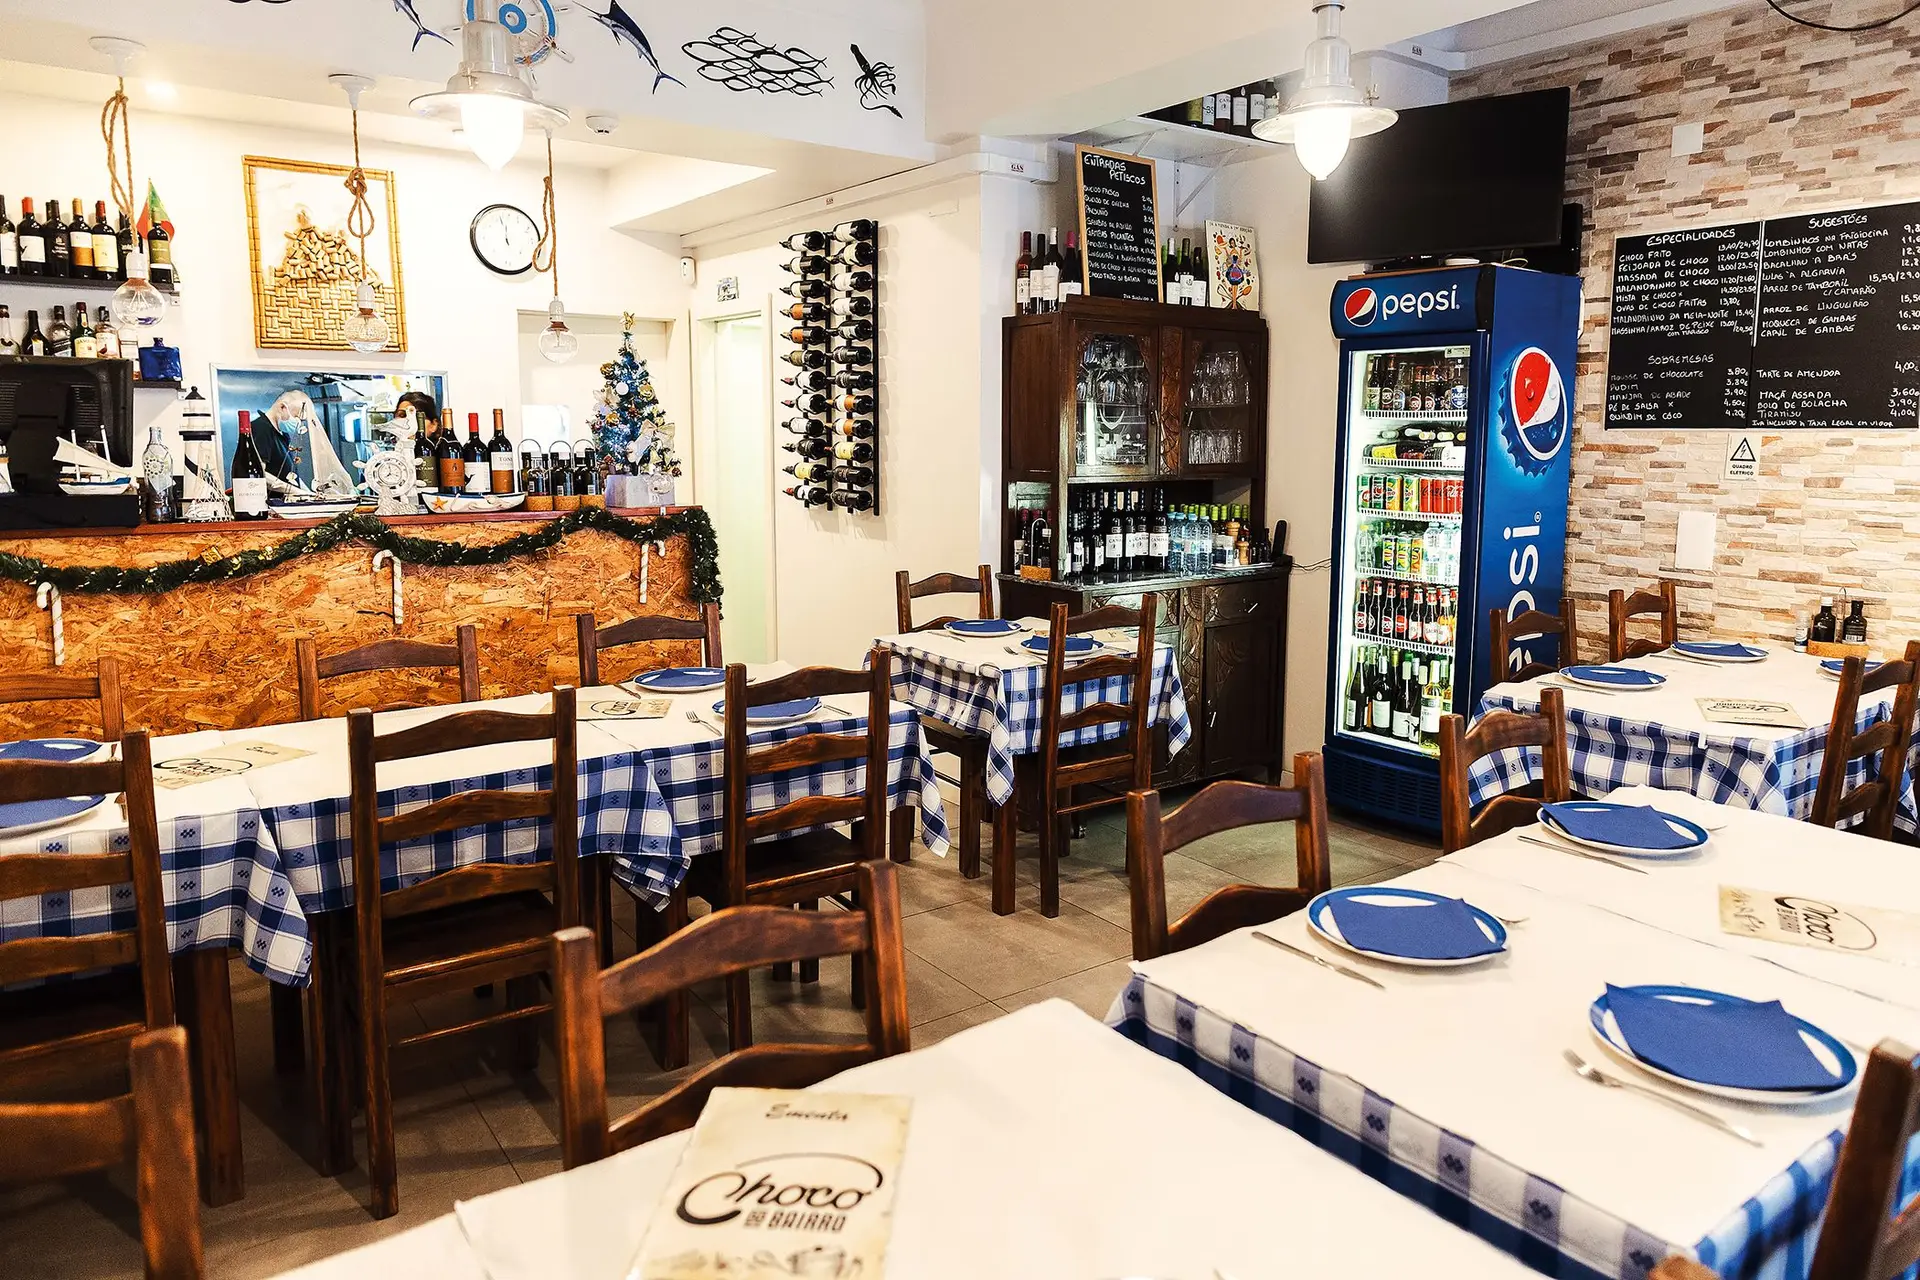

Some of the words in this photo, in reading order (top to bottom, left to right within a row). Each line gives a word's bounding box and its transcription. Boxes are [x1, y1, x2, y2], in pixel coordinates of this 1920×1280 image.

[1084, 154, 1126, 171] ENTRADAS
[1109, 169, 1146, 185] PETISCOS
[1808, 213, 1868, 229] SUGESTÕES
[1647, 228, 1735, 246] ESPECIALIDADES
[1765, 236, 1820, 248] LOMBINHOS
[1825, 234, 1836, 242] NA
[1839, 229, 1889, 240] FRIGIDEIRA
[1619, 254, 1644, 262] CHOCO
[1648, 250, 1672, 259] FRITO
[1764, 247, 1811, 258] LOMBINHOS
[1839, 241, 1869, 250] NATAS
[1618, 260, 1661, 273] FEIJOADA
[1680, 258, 1709, 266] CHOCO
[1763, 259, 1808, 270] BACALHAU
[1618, 272, 1657, 282] MASSADA
[1680, 268, 1710, 276] CHOCO
[1762, 273, 1784, 281] LULAS
[1801, 267, 1845, 277] ALGARVIA
[1763, 283, 1789, 293] ARROZ
[1806, 279, 1849, 290] TAMBORIL
[1834, 285, 1876, 296] CAMARÃO
[1382, 284, 1457, 320] pepsi
[1616, 294, 1636, 302] MISTA
[1616, 304, 1635, 313] OVAS
[1652, 301, 1675, 309] CHOCO
[1679, 298, 1707, 307] FRITAS
[1763, 306, 1792, 314] ARROZ
[1817, 299, 1870, 310] LINGUEIRÃO
[1669, 312, 1680, 320] DA
[1684, 309, 1729, 320] MEIA-NOITE
[1762, 318, 1800, 328] MOQUECA
[1808, 316, 1818, 324] DE
[1822, 314, 1857, 324] GAMBAS
[1761, 328, 1787, 337] CARIL
[1814, 324, 1856, 334] GAMBAS
[1648, 354, 1714, 365] SOBREMESAS
[1660, 370, 1704, 379] CHOCOLATE
[1756, 369, 1781, 378] TARTE
[1796, 370, 1841, 378] AMENDOA
[1665, 391, 1692, 399] ABADE
[1759, 390, 1786, 400] MAÇÃ
[1791, 391, 1832, 399] ASSADA
[1634, 402, 1659, 410] SALSA
[1801, 400, 1848, 408] BOLACHA
[1609, 412, 1642, 421] QUINDIM
[676, 1171, 871, 1226] Choco
[768, 1210, 848, 1233] BAIRRO
